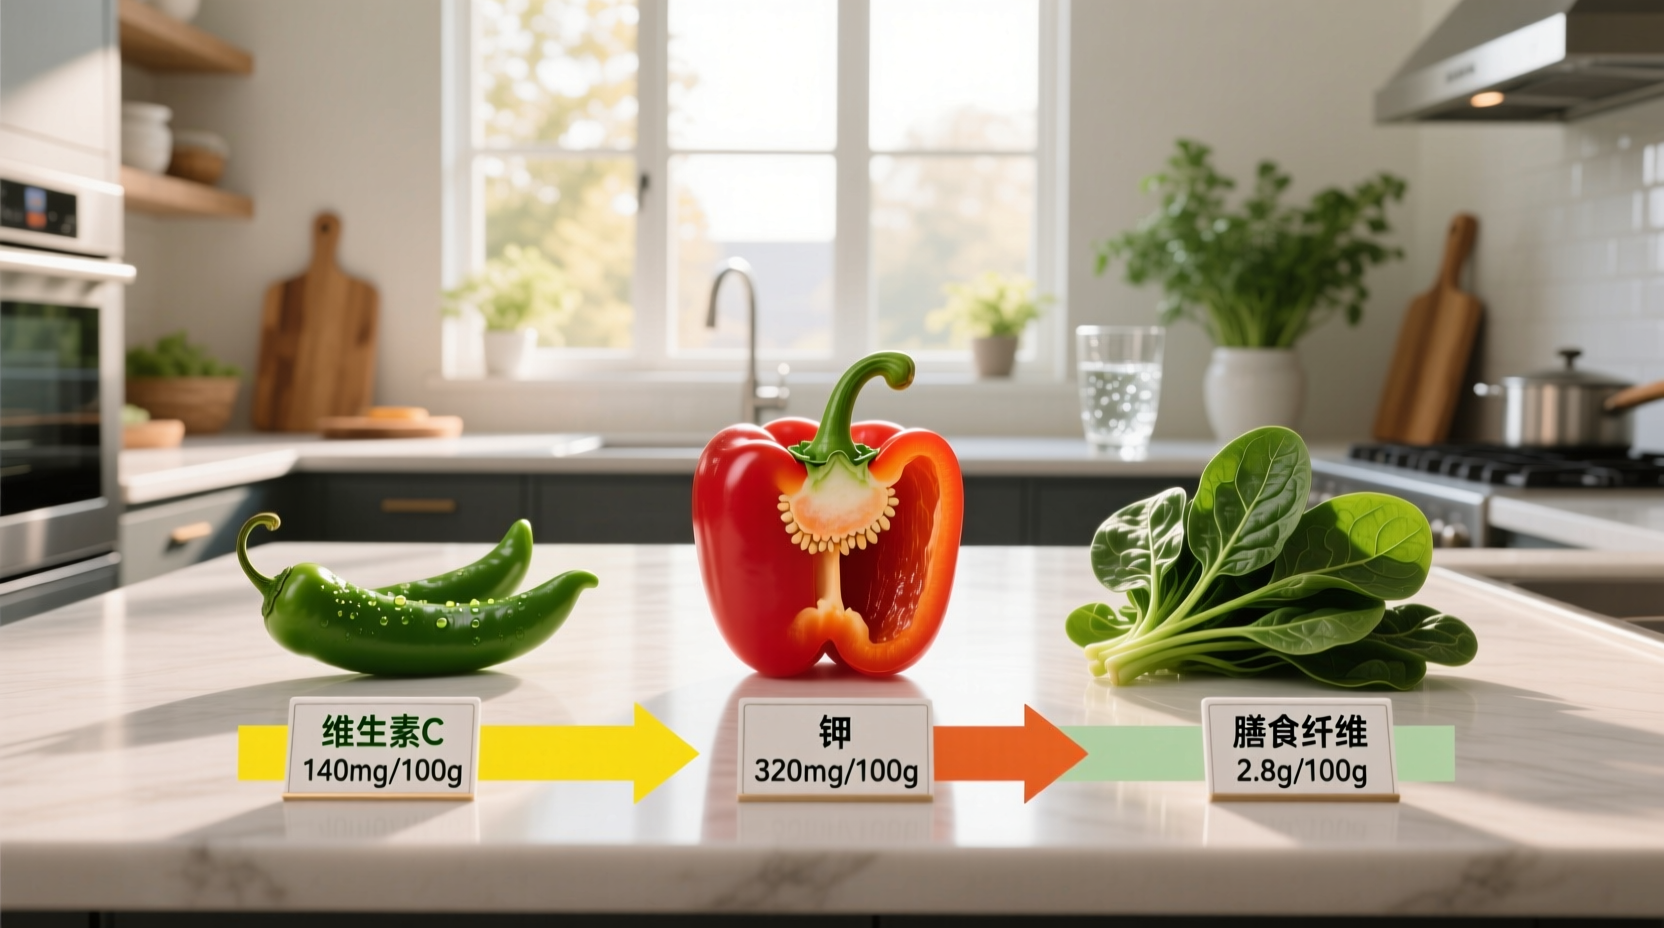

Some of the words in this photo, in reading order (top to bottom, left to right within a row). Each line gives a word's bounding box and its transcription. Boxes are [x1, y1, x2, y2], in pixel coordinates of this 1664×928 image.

[321, 713, 443, 748] 维生素C
[819, 714, 851, 749] 钾
[1233, 713, 1369, 748] 膳食纤维
[303, 757, 463, 788] 140mg/100g
[754, 757, 918, 789] 320mg/100g
[1237, 757, 1367, 788] 2.8g/100g
